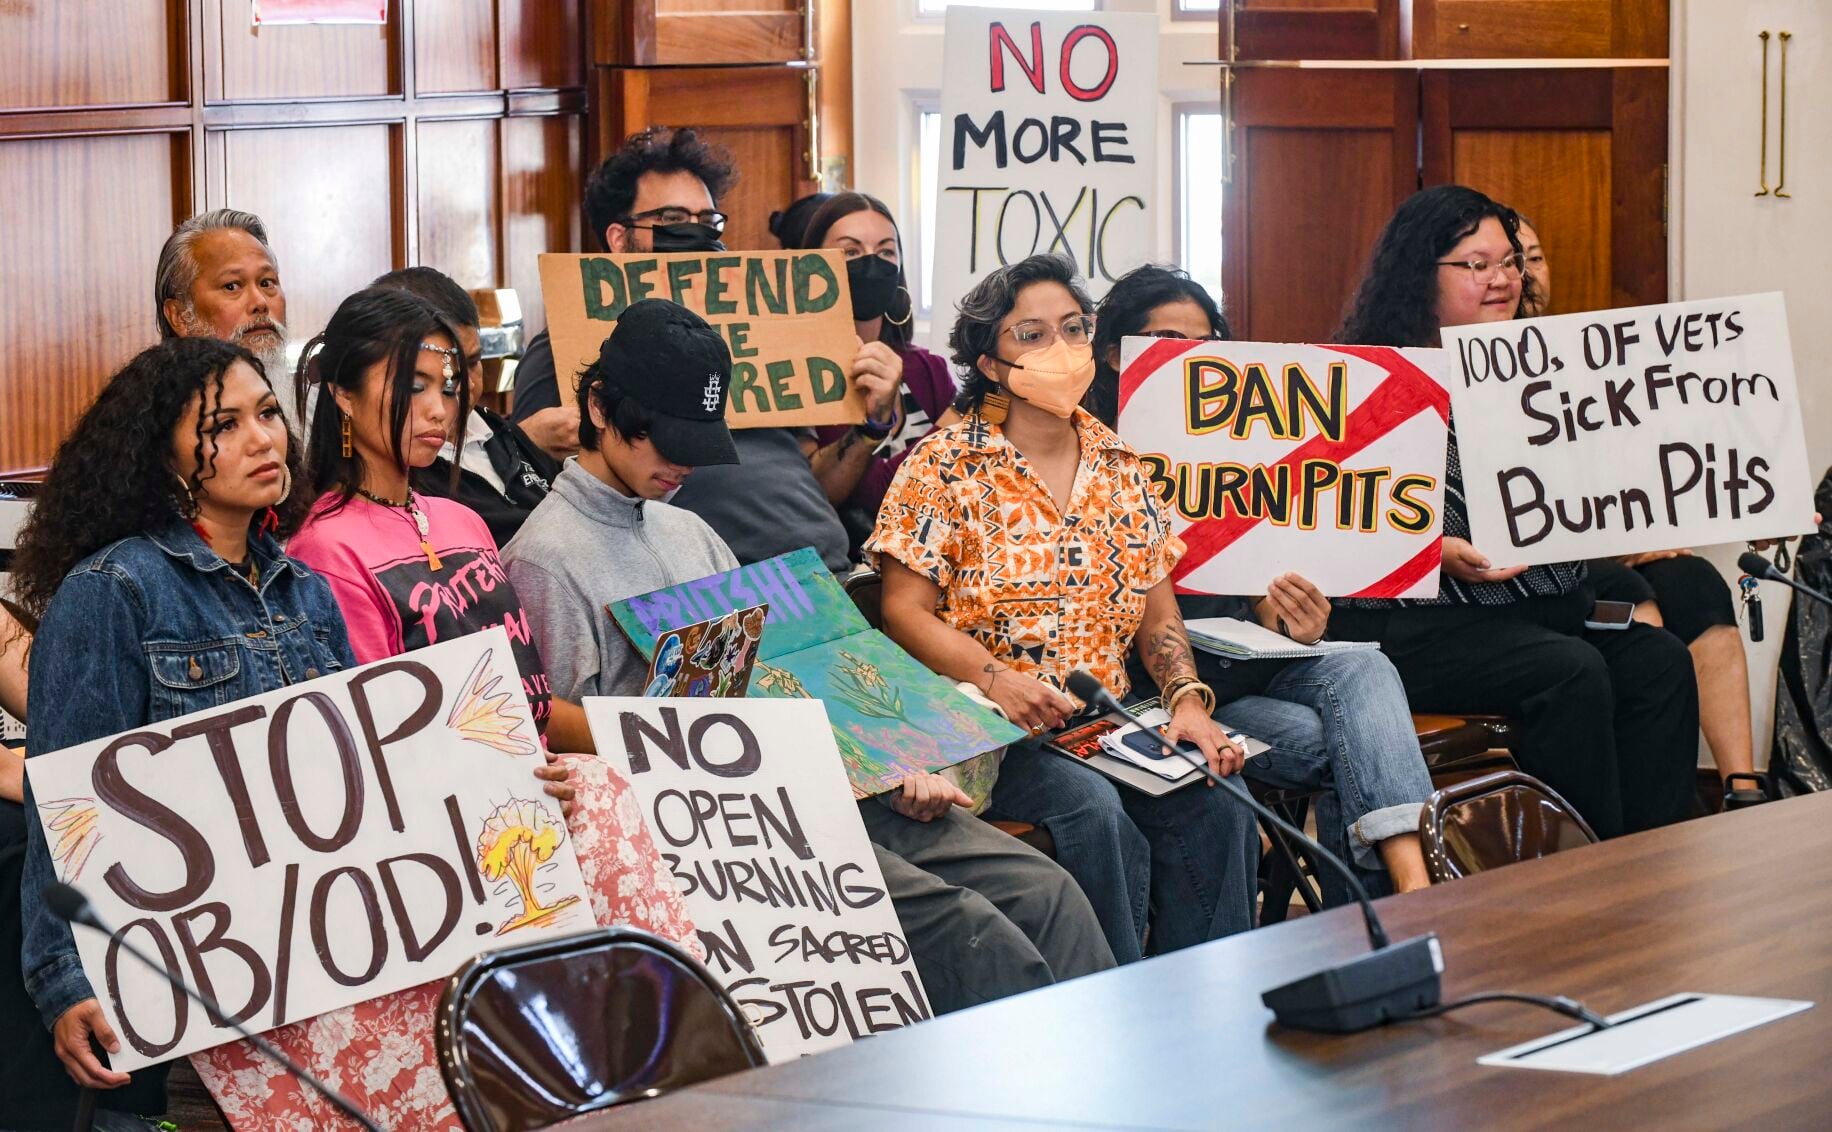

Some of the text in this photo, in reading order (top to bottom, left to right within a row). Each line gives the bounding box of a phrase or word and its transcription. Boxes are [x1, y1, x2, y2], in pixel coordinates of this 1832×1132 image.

[990, 21, 1119, 102] NO
[953, 110, 1136, 170] MORE
[944, 186, 1146, 283] TOXIC
[580, 253, 840, 321] DEFEND
[1581, 319, 1640, 371] OF
[729, 357, 847, 413] RED
[1184, 356, 1347, 442] BAN
[1139, 453, 1437, 534] BURN PITS
[1497, 442, 1775, 548] Burn Pits
[618, 707, 762, 777] NO
[92, 660, 443, 911] STOP
[653, 786, 815, 860] OPEN
[661, 853, 886, 916] BURNING
[768, 924, 910, 965] SACRED
[727, 971, 933, 1039] STOLEN
